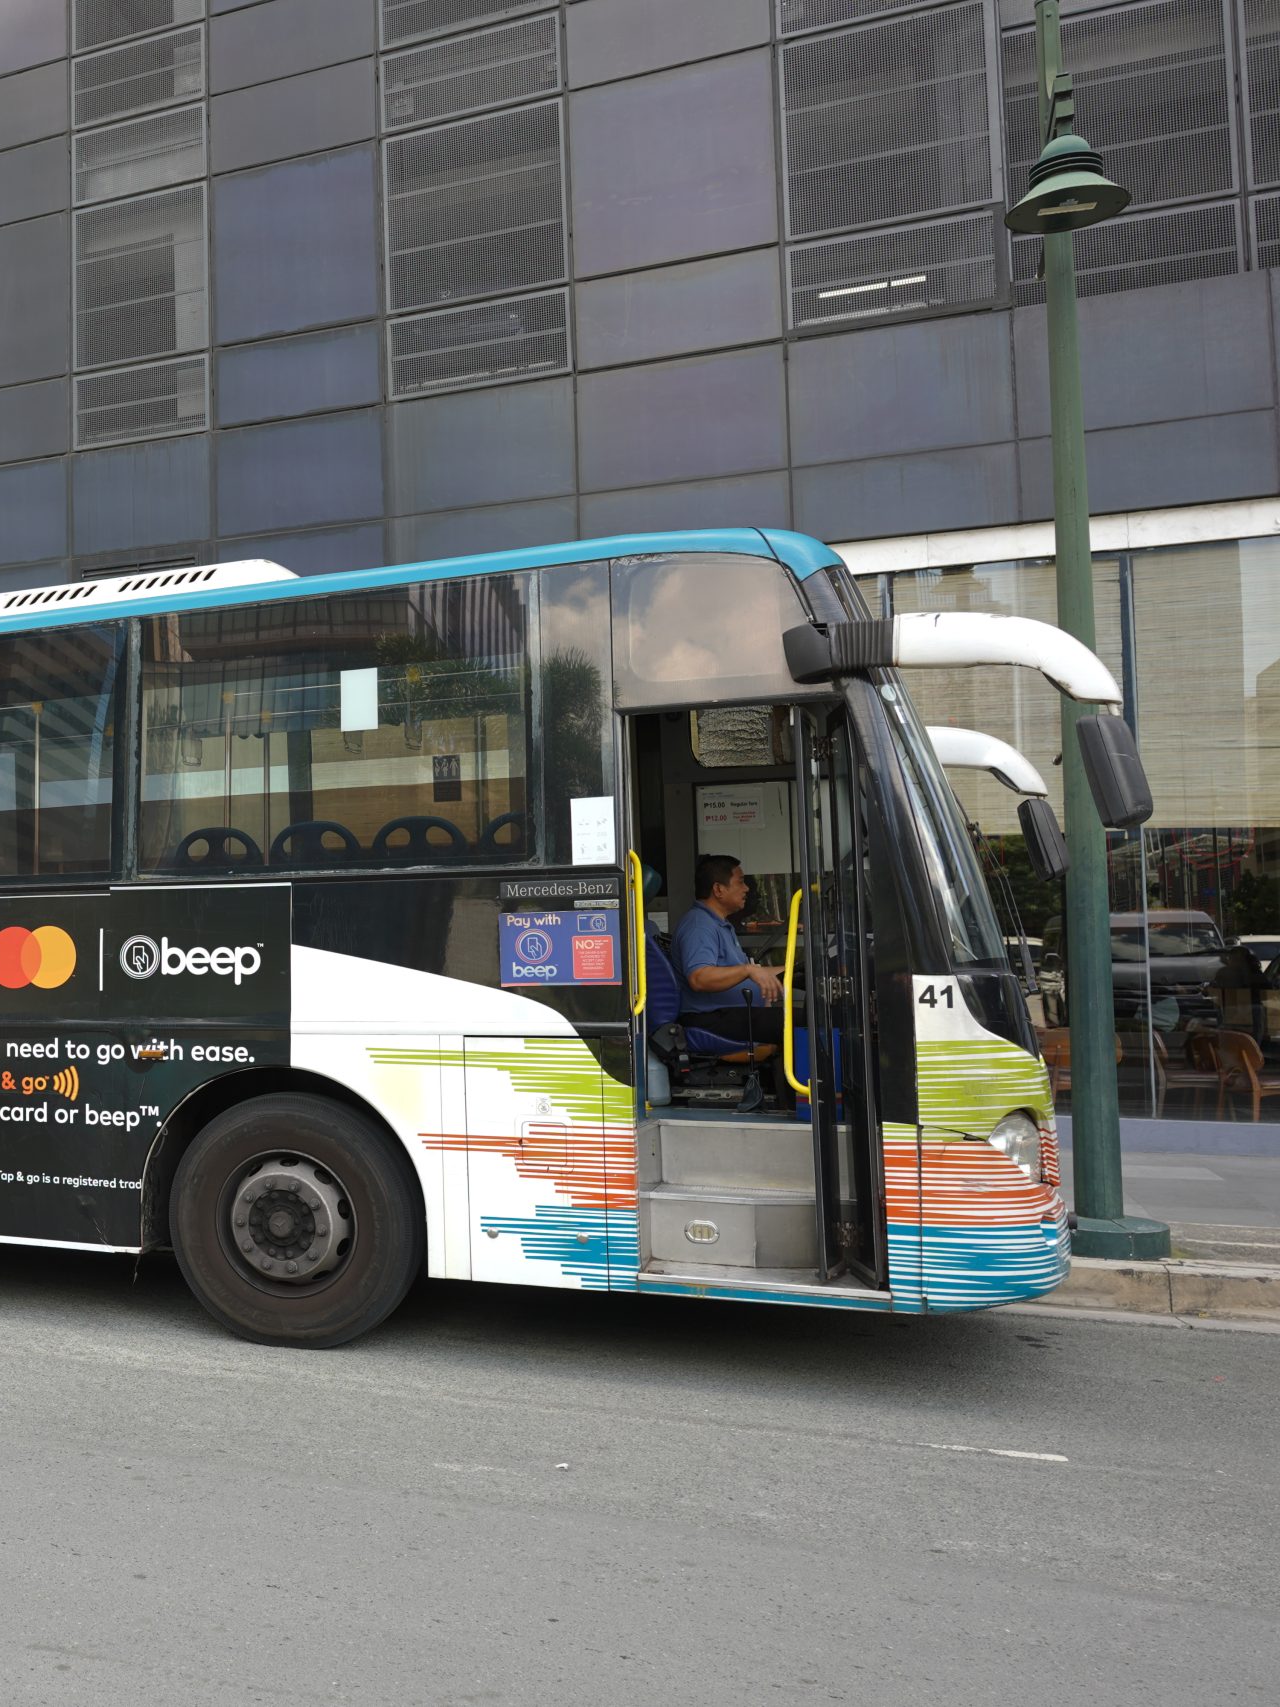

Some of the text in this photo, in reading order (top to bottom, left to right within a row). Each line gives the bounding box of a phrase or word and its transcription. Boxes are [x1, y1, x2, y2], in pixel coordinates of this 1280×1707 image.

[506, 881, 613, 897] Mercedes-Benz
[506, 913, 561, 929] Pay with
[575, 939, 595, 950] NO
[512, 962, 558, 981] beep
[918, 984, 954, 1009] 41
[6, 1038, 59, 1059] need
[64, 1040, 90, 1059] to
[96, 1044, 125, 1066] go
[190, 1045, 255, 1064] ease.
[1, 1070, 16, 1090] &
[54, 1109, 79, 1124] or
[16, 1171, 24, 1182] &
[26, 1175, 40, 1184] go
[42, 1173, 51, 1184] is
[62, 1175, 117, 1188] registered
